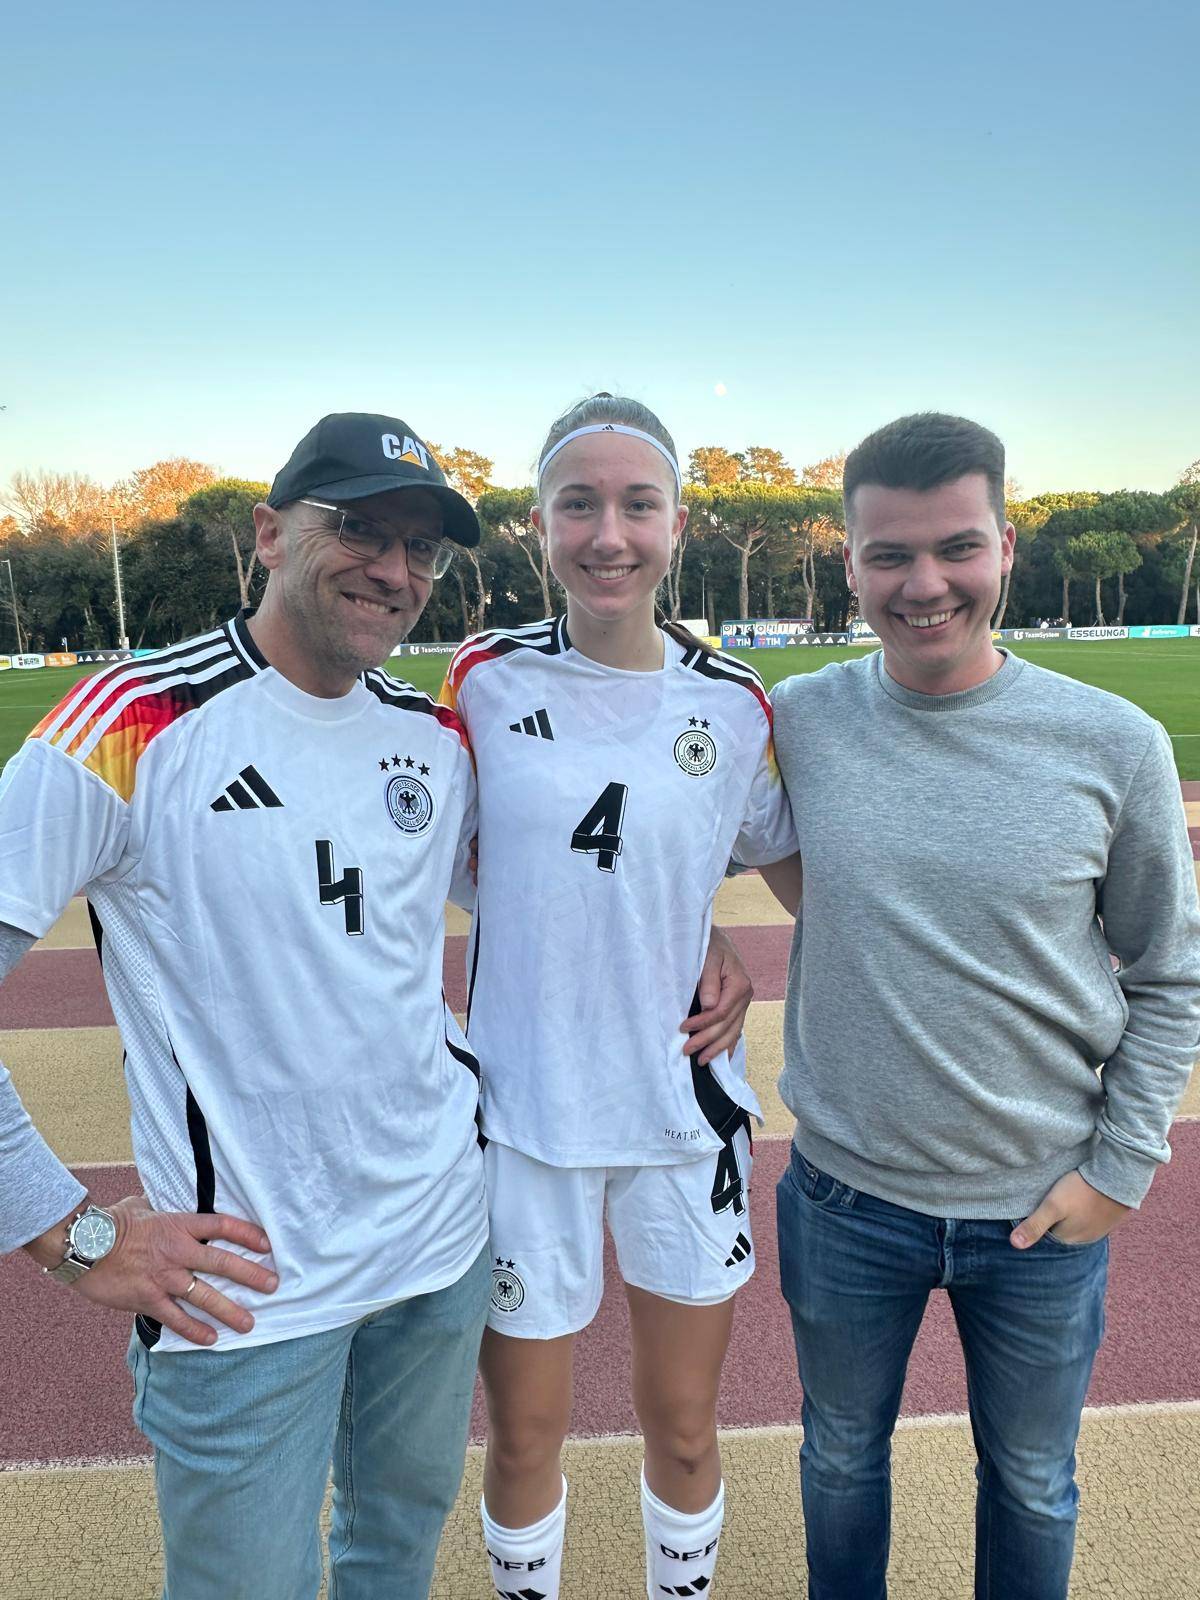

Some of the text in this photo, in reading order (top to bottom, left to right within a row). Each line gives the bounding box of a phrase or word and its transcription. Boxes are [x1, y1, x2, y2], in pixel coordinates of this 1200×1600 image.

[381, 433, 431, 471] CAT
[421, 646, 458, 654] TeamSystem
[1025, 631, 1060, 639] TeamSystem
[1070, 628, 1126, 638] ESSELUNGA
[570, 781, 629, 874] 4
[315, 839, 365, 937] 4
[710, 1136, 746, 1217] 4
